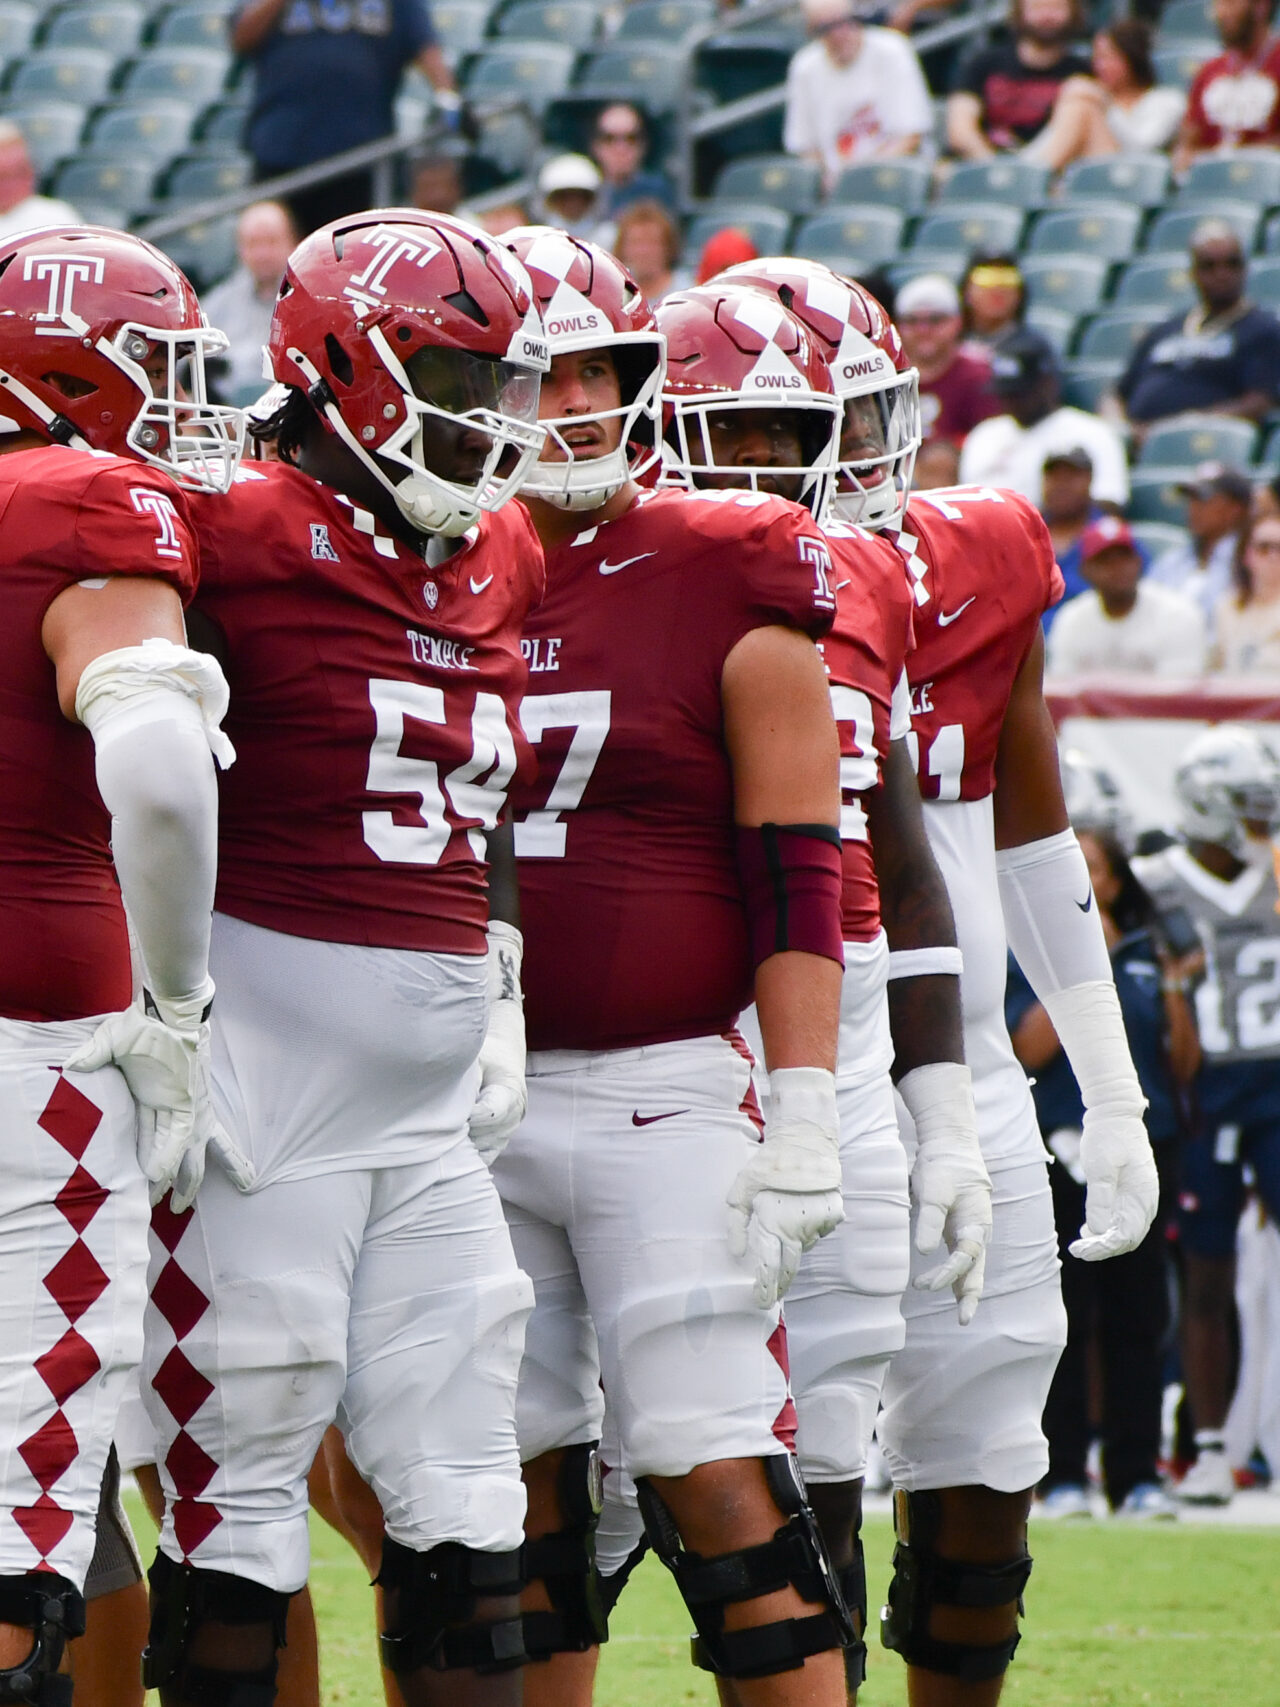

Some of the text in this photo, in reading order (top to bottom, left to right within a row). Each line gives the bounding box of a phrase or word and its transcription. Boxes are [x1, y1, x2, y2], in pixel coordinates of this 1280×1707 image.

[343, 224, 442, 307] T
[24, 254, 105, 337] T
[523, 341, 548, 361] OWLS
[548, 315, 598, 335] OWLS
[754, 374, 801, 389] OWLS
[843, 357, 884, 380] OWLS
[130, 487, 182, 559] T
[798, 535, 835, 610] T
[407, 629, 480, 671] TEMPLE
[362, 678, 517, 865] 54
